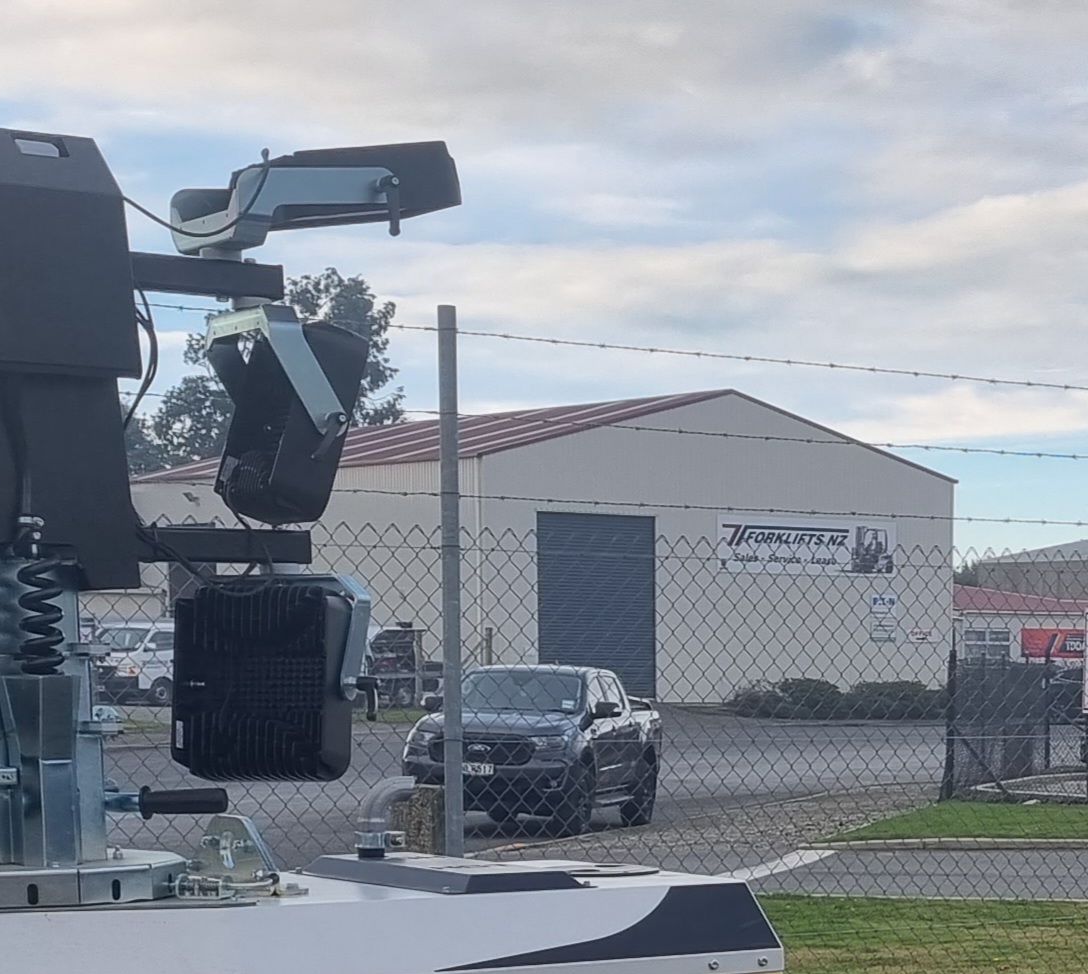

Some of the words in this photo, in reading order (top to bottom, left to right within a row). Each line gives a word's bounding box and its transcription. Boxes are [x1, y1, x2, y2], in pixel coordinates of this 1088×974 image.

[746, 531, 826, 546] FORKLIFTS
[733, 552, 759, 562] Sales
[768, 553, 801, 564] Service
